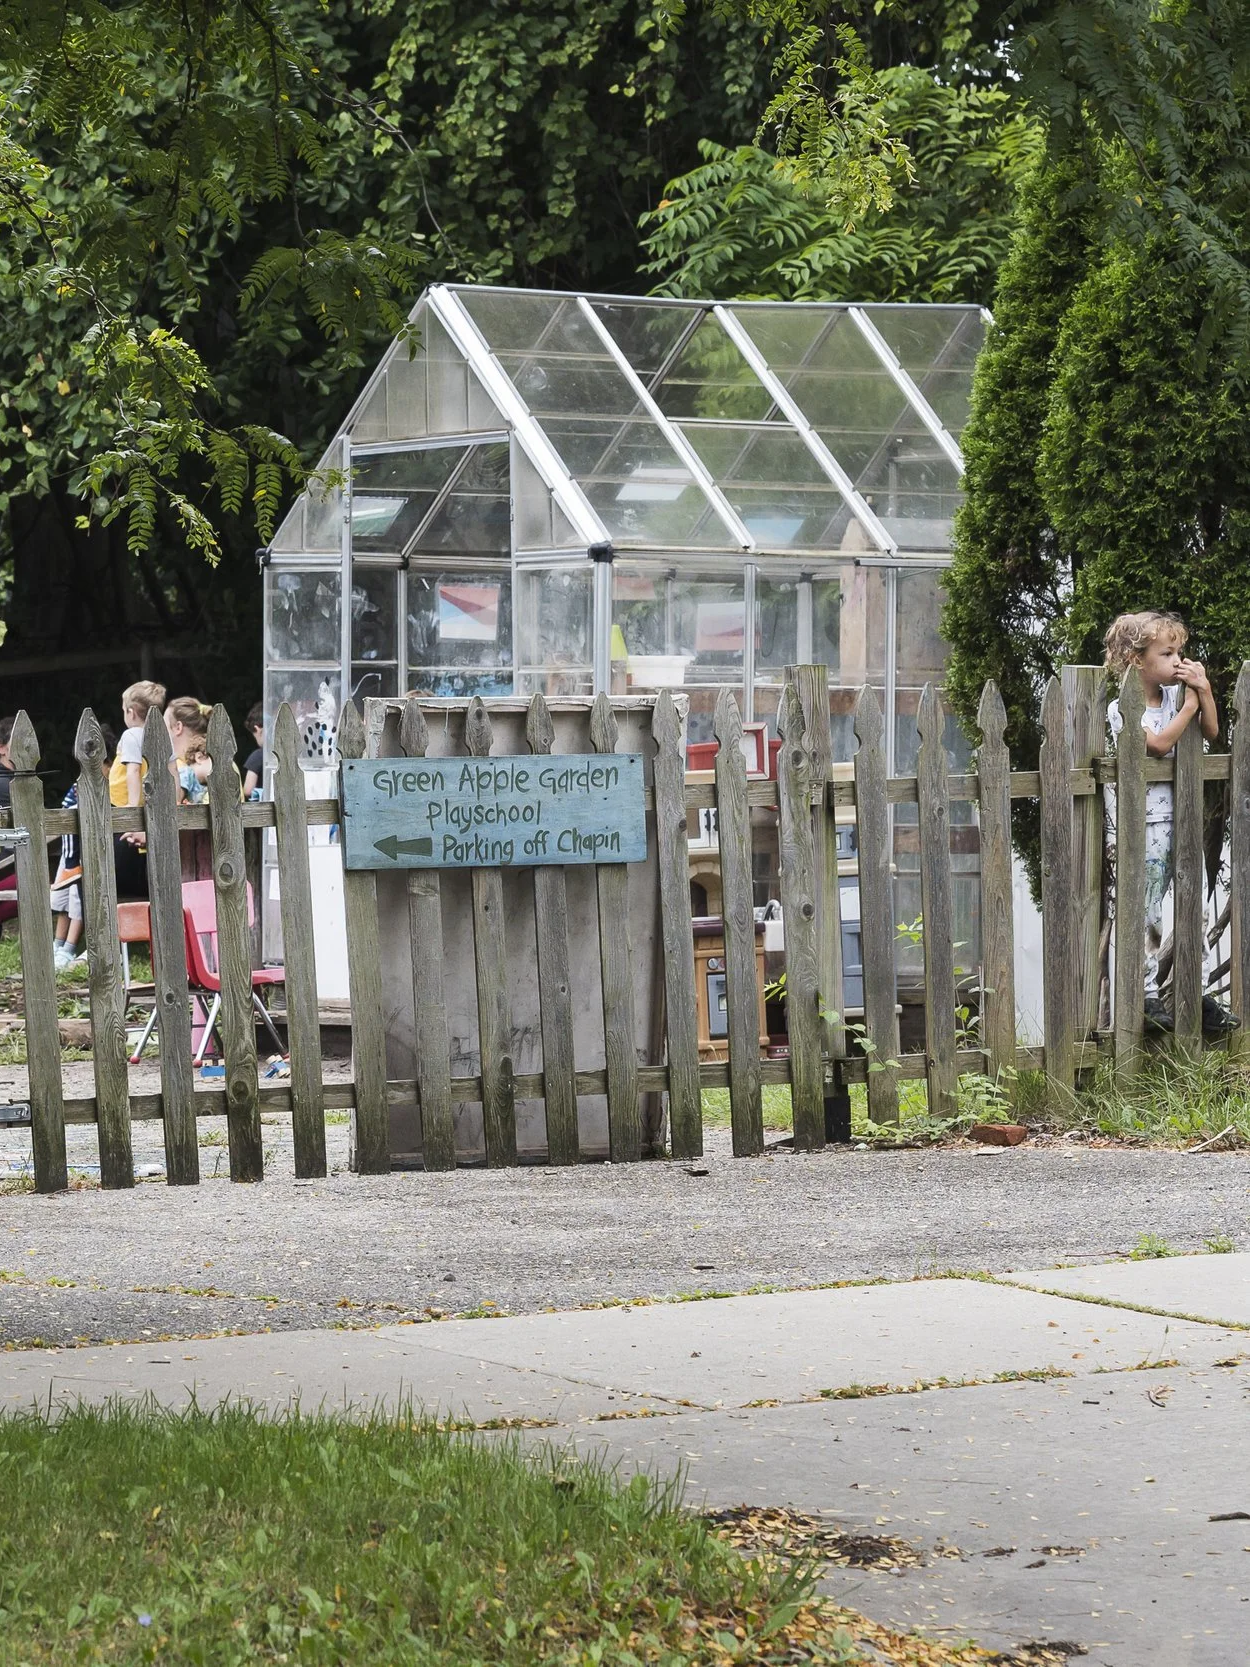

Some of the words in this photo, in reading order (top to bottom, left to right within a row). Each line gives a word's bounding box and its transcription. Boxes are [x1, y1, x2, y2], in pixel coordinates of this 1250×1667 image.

[373, 769, 444, 798] Green
[459, 763, 530, 800] Apple
[539, 761, 619, 796] Garden
[426, 799, 540, 834] Playschool
[442, 833, 514, 864] Parking
[524, 829, 550, 855] off
[557, 827, 621, 859] Chapin
